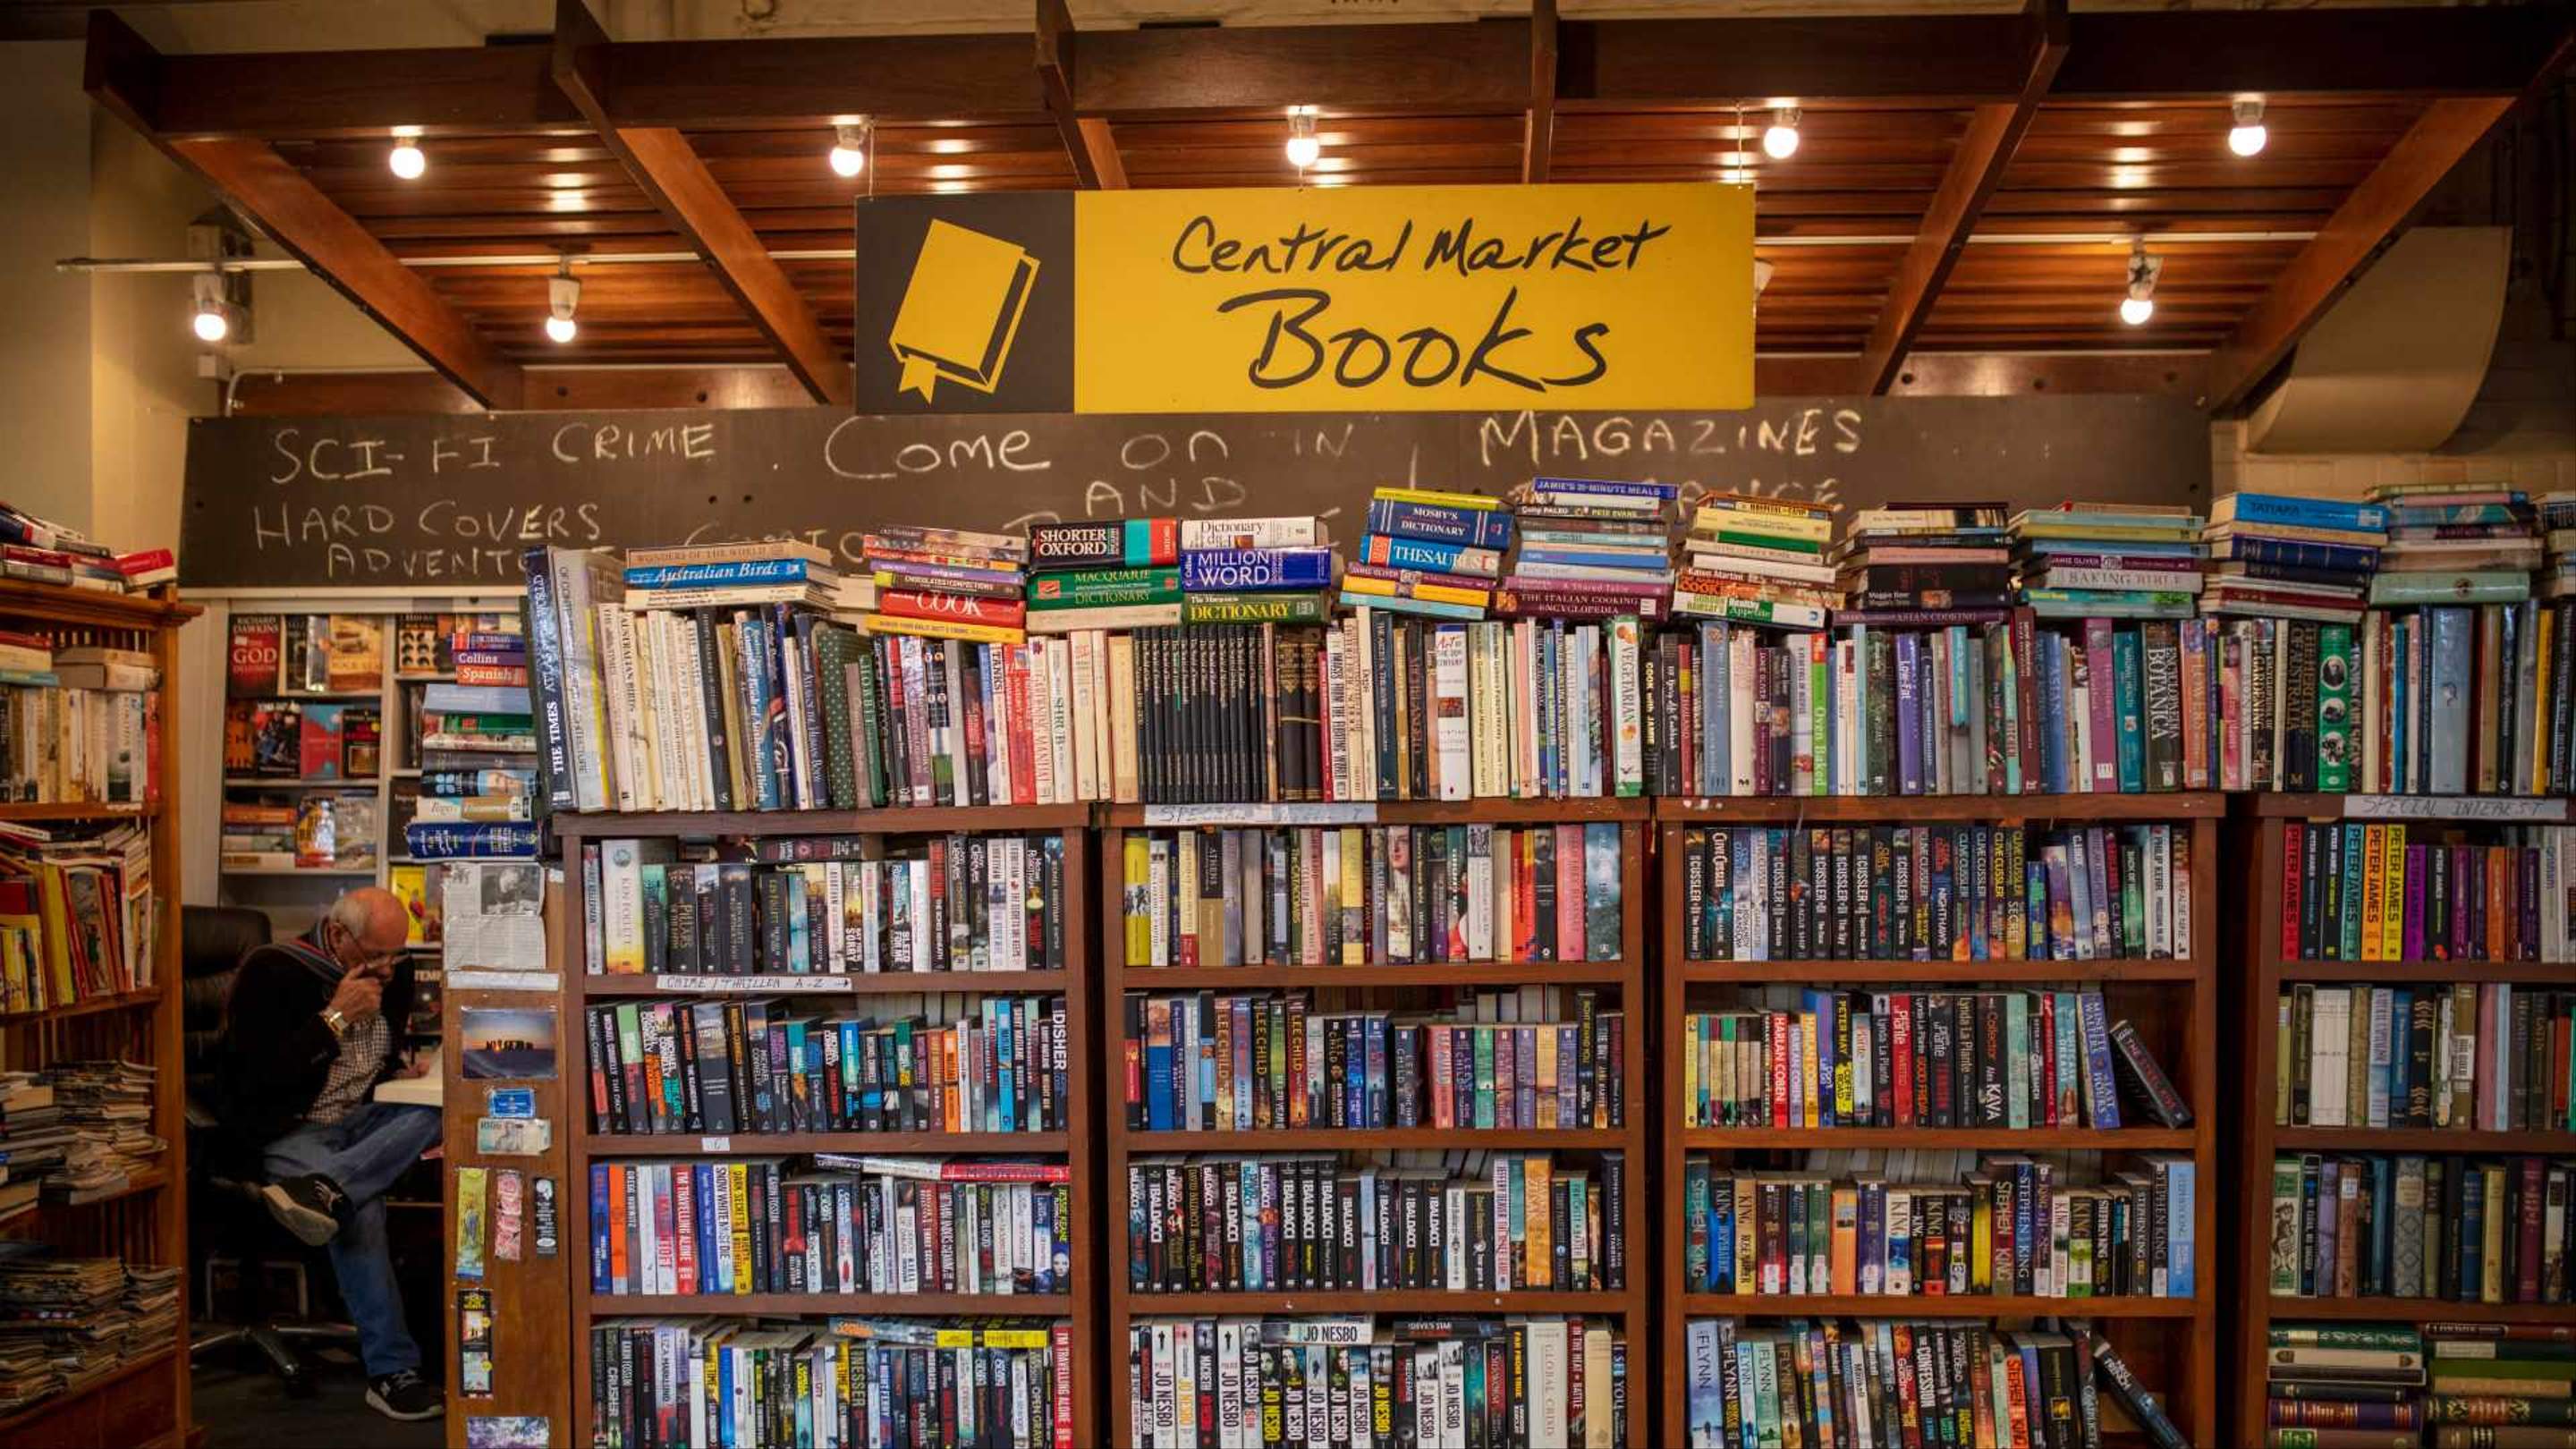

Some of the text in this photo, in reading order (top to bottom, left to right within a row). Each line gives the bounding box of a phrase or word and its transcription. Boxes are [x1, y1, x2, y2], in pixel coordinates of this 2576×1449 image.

[1172, 215, 1673, 277] Central Market
[1216, 285, 1611, 393] Books
[551, 422, 716, 464] CRIME
[1479, 409, 1861, 468] MAGAZINES
[1084, 477, 1247, 517] AND
[1412, 506, 1459, 521] MOSBY'S
[254, 499, 600, 549] HARD COVERS
[1038, 529, 1106, 543] SHORTER
[1200, 521, 1266, 536] Dictionary
[1401, 521, 1465, 537] DICTIONARY
[1038, 541, 1106, 555] OXFORD
[1198, 551, 1269, 566] MILLION
[655, 561, 778, 583] Australian Birds
[1198, 566, 1270, 585] WORD
[2070, 572, 2131, 585] BAKING
[915, 591, 982, 616] COOK
[1074, 591, 1151, 605] DICTIONARY
[1190, 602, 1290, 621] DICTIONARY
[1521, 592, 1638, 606] THE ITALIAN COOKING
[1538, 604, 1618, 614] ENCYCLOPEDIA
[233, 648, 277, 664] GOD
[458, 652, 498, 665] Collins
[462, 667, 513, 680] Spanish
[992, 650, 1003, 691] TANKS
[860, 664, 876, 724] HOBBIT
[1332, 682, 1344, 703] FROM
[1621, 646, 1637, 723] VEGETARIAN
[1899, 660, 1911, 699] Low-Fat
[2049, 665, 2061, 716] ASIAN
[2148, 648, 2167, 741] BOTANICA
[2165, 648, 2179, 739] ENCYCLOPAEDIA
[2253, 656, 2266, 730] GARDENING
[2287, 627, 2303, 731] OF AUSTRALIA
[1055, 697, 1068, 745] SHRUB
[1333, 706, 1345, 717] THE
[1645, 661, 1656, 745] COOK with JAMIE
[546, 701, 564, 775] THE TIMES
[1814, 706, 1826, 787] Oven Baked
[1208, 847, 1217, 886] ATHENS
[1836, 862, 1848, 902] CUSSLER
[1856, 860, 1868, 902] CUSSLER
[1897, 860, 1908, 902] CUSSLER
[2153, 836, 2164, 891] PHILIP KERR
[2346, 828, 2361, 922] PETER JAMES
[2368, 829, 2383, 923] PETER JAMES
[2388, 827, 2402, 922] PETER JAMES
[621, 876, 631, 945] KEN FOLLETT
[1937, 887, 1947, 945] NIGHTHAWK
[2007, 901, 2019, 944] SECRET
[845, 928, 856, 962] SORRY
[894, 931, 902, 962] FOR ME
[902, 931, 911, 963] BLEED
[1053, 1013, 1066, 1070] DISHER
[1217, 1014, 1229, 1078] LEE CHILD
[1255, 1012, 1268, 1075] LEE CHILD
[1291, 1014, 1302, 1072] LEE CHILD
[1836, 1001, 1848, 1055] PETER MAY
[1958, 996, 1974, 1074] Lynda La Plante
[2084, 1001, 2098, 1055] WALTERS
[658, 1037, 672, 1078] CONNELLY
[752, 1047, 764, 1086] CONNELLY
[758, 1047, 769, 1082] MICHAEL
[1774, 1016, 1787, 1102] HARLAN COBEN
[1877, 1018, 1892, 1084] Lynda La Plante
[1986, 1012, 2002, 1121] Collector Alex KAVA
[2093, 1072, 2107, 1114] HOURS
[716, 1167, 729, 1192] SNOW
[717, 1195, 730, 1223] WHITE
[1283, 1183, 1293, 1239] BALDACCI
[1302, 1183, 1313, 1239] BALDACCI
[1322, 1184, 1333, 1239] BALDACCI
[1343, 1200, 1353, 1247] BALDACCI
[1892, 1201, 1907, 1235] KING
[1926, 1201, 1942, 1236] KING
[2018, 1175, 2030, 1278] STEPHEN KING
[2072, 1201, 2089, 1237] KING
[719, 1245, 731, 1259] DIE
[1303, 1326, 1357, 1342] JO NESBO
[851, 1357, 866, 1407] NESSER
[1200, 1355, 1213, 1391] MACBETH
[1513, 1331, 1522, 1398] FAR FROM TRUE
[1740, 1347, 1752, 1386] FLYNN
[1759, 1349, 1772, 1392] FLYNN
[1779, 1349, 1795, 1394] FLYNN
[1897, 1357, 1910, 1400] Gardner
[1917, 1346, 1936, 1408] CONFESSION
[607, 1367, 619, 1417] CRUSHER
[1353, 1386, 1367, 1434] JO NESBO
[1544, 1343, 1555, 1437] GLOBAL CRISIS
[1031, 1386, 1043, 1448] OPEN GRAVE
[1286, 1387, 1303, 1440] JO NESBO
[1309, 1389, 1326, 1442] JO NESBO
[1331, 1386, 1348, 1440] JO NESBO
